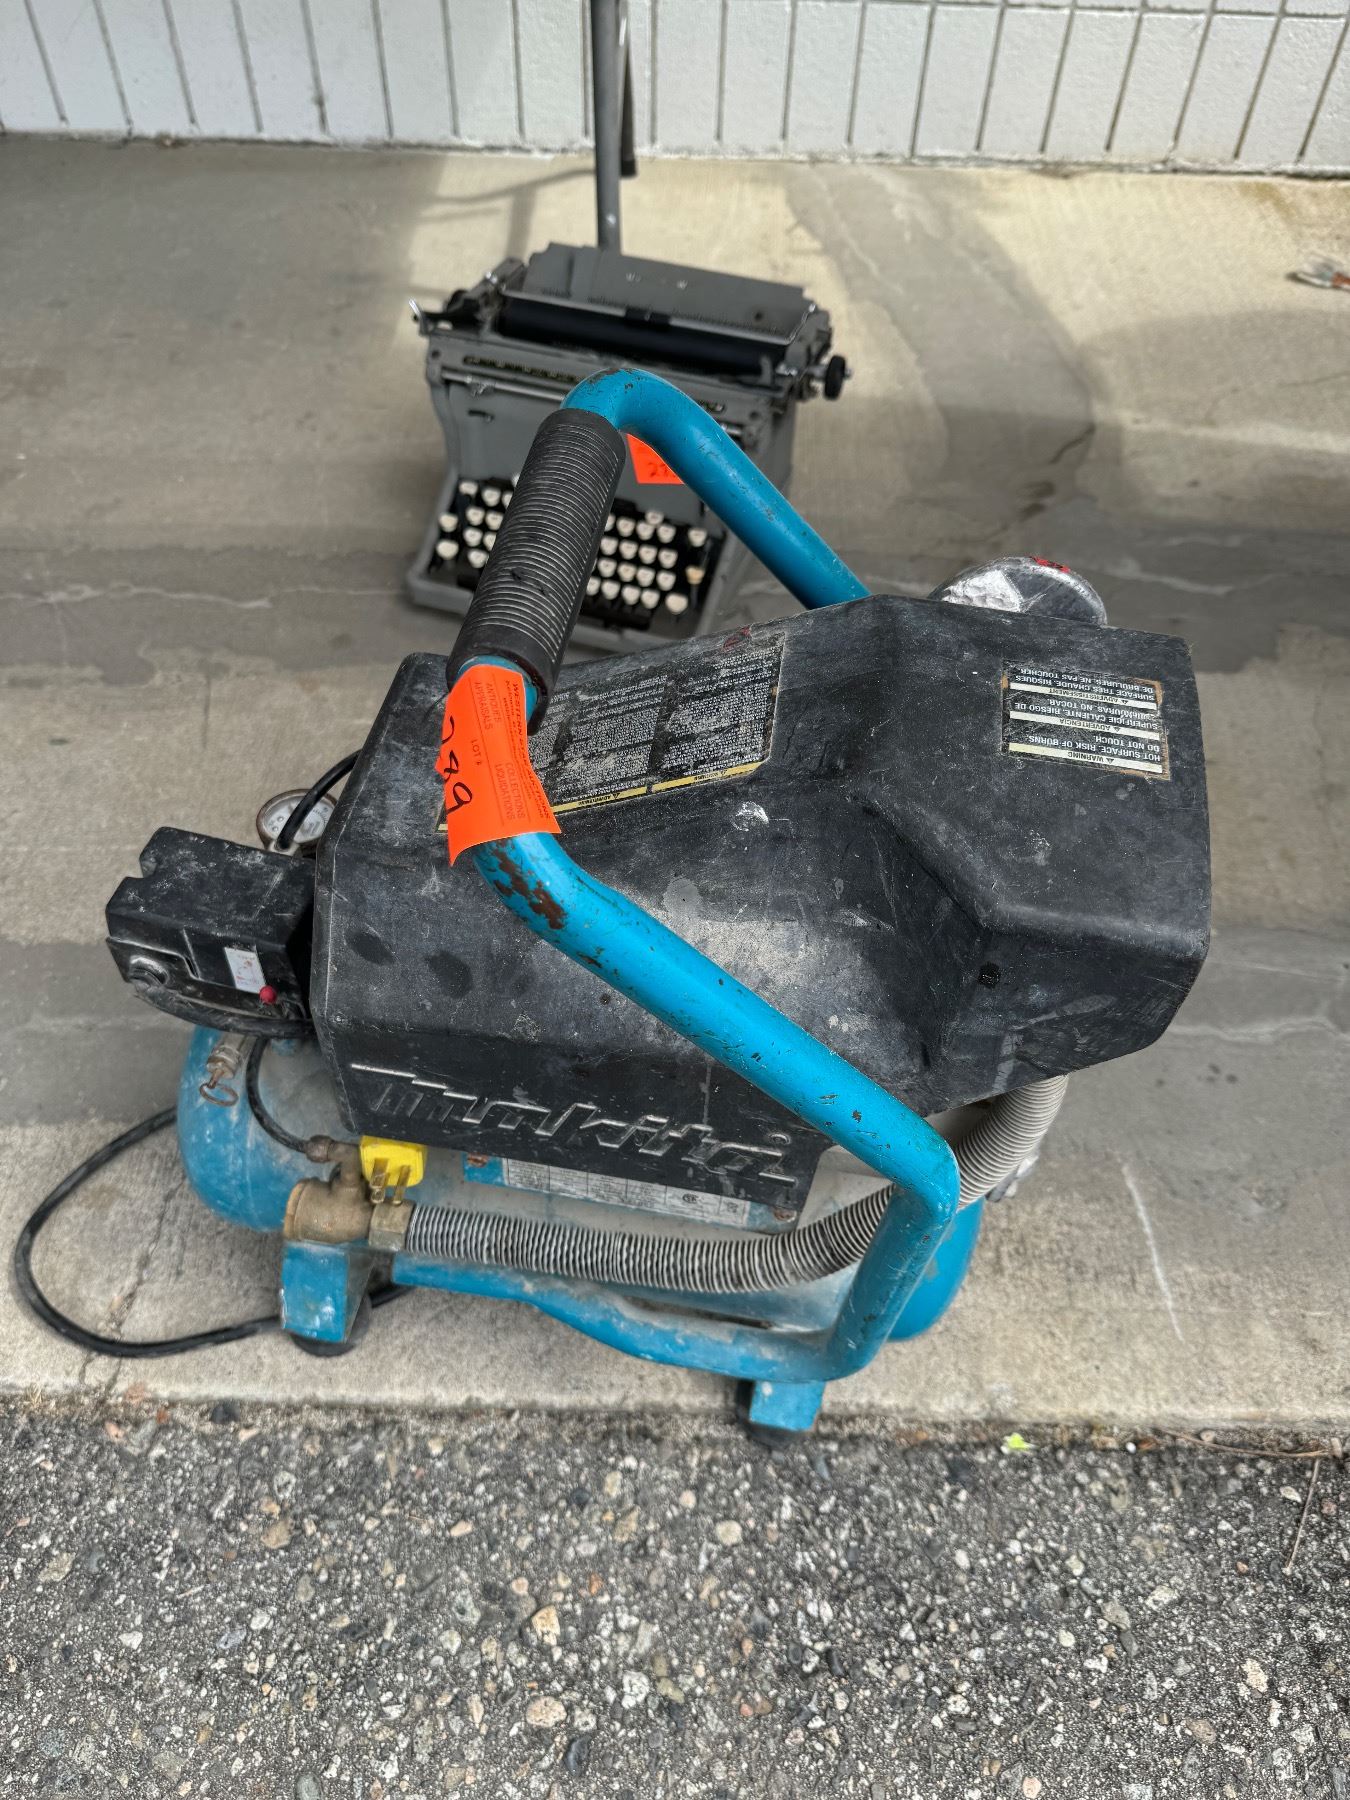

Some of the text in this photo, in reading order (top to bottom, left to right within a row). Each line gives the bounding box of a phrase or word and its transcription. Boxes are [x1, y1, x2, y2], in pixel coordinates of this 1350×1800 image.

[1015, 675, 1053, 686] RISQUES
[1053, 680, 1090, 691] CHAUDE.
[1116, 689, 1155, 701] SURFACE
[1141, 686, 1154, 694] DE
[1047, 698, 1078, 709] TOCAR.
[1080, 703, 1093, 711] NO
[1014, 702, 1158, 730] SUPERFICIE CALIENTE. RIESGO DE
[1059, 718, 1111, 731] ADVERTENCIA
[1028, 735, 1059, 746] BURNS.
[1093, 735, 1160, 752] DO NOT TOUCH.
[470, 739, 481, 757] LOT
[473, 681, 516, 820] APPRAISALS LIQUIDATIONS
[485, 682, 502, 724] ANTIQUES
[504, 762, 526, 820] COLLECTIONS
[1075, 743, 1096, 751] RISK
[1101, 746, 1142, 759] SURFACE.
[1068, 751, 1104, 762] WARNING
[1143, 753, 1161, 762] HOT
[527, 768, 551, 819] AUCTIONS
